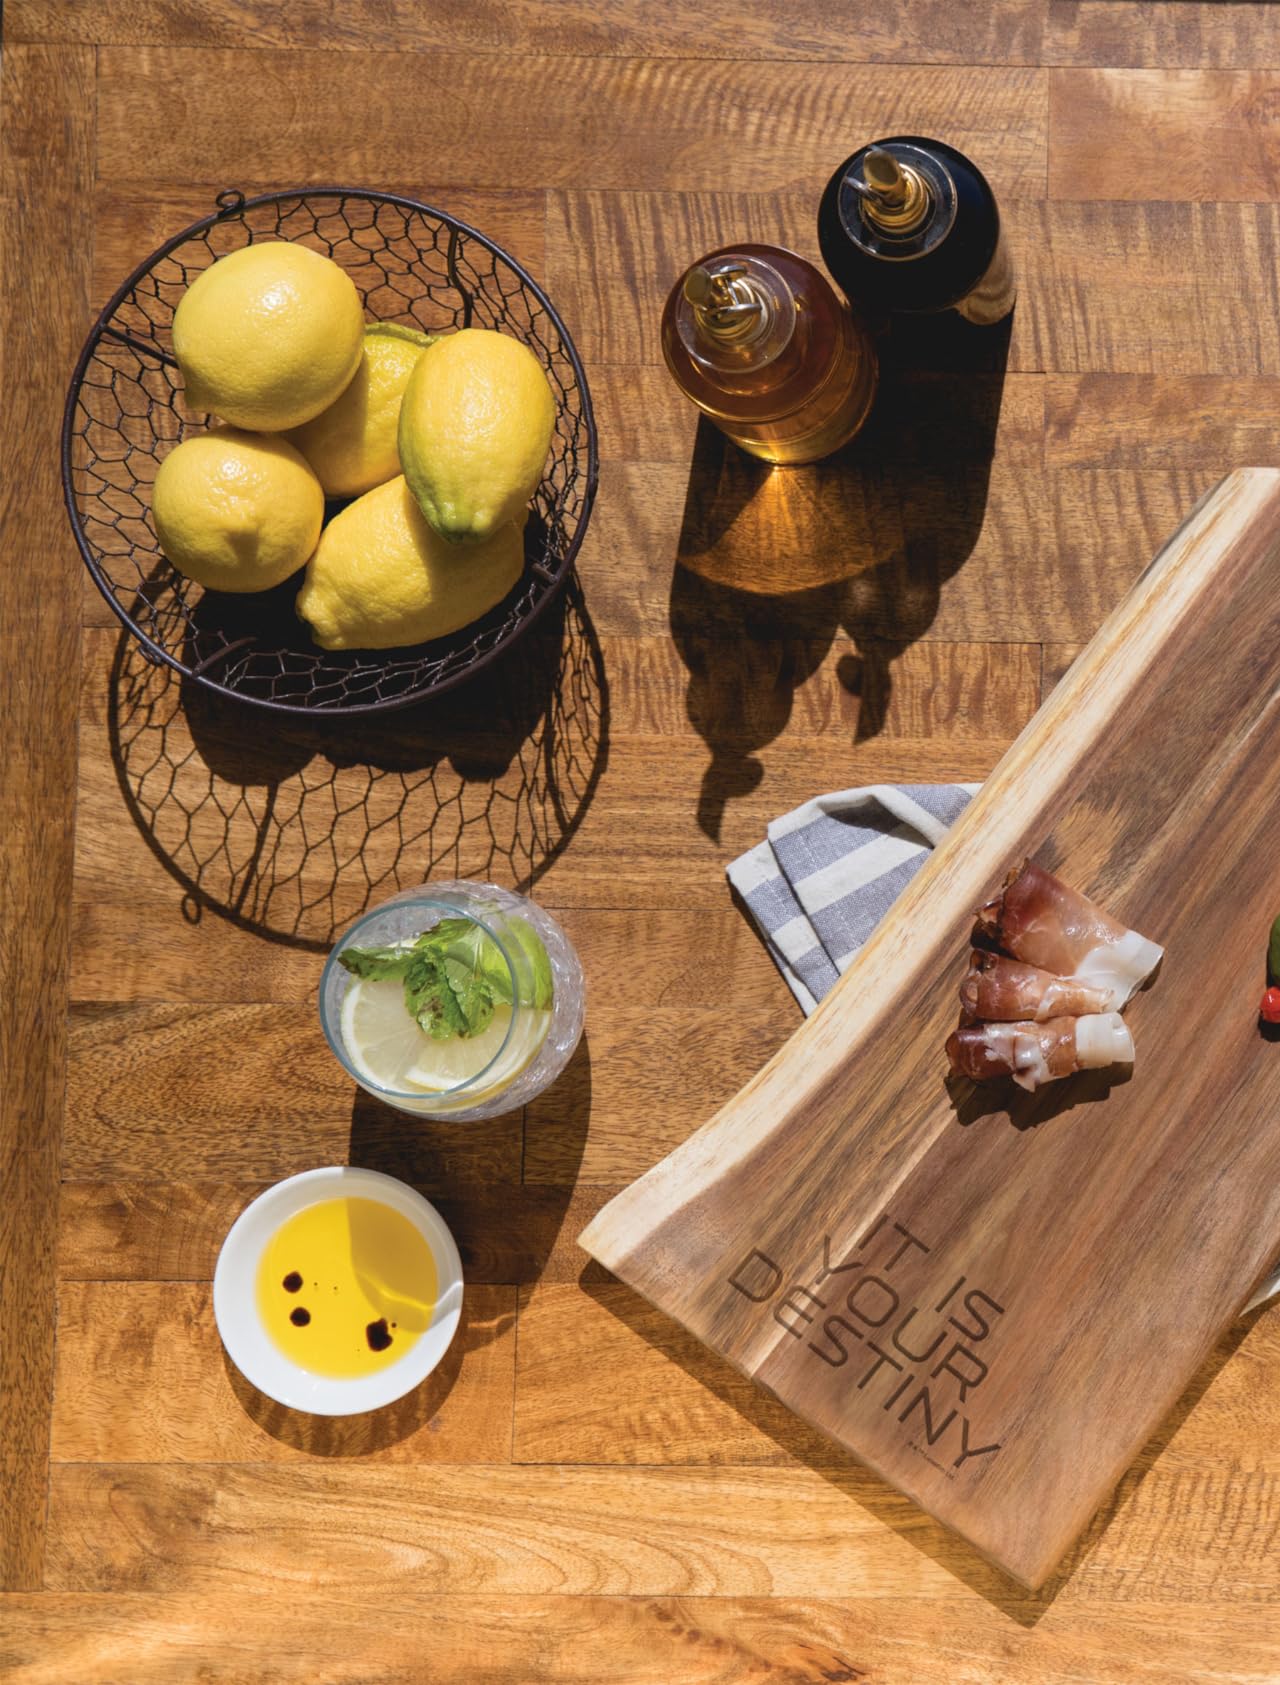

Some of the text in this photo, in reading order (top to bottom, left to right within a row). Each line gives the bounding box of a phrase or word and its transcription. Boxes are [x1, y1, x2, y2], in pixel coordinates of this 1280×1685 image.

[727, 1247, 1002, 1468] DESTINY
[815, 1234, 989, 1403] YOUR
[858, 1213, 1005, 1342] IT IS
